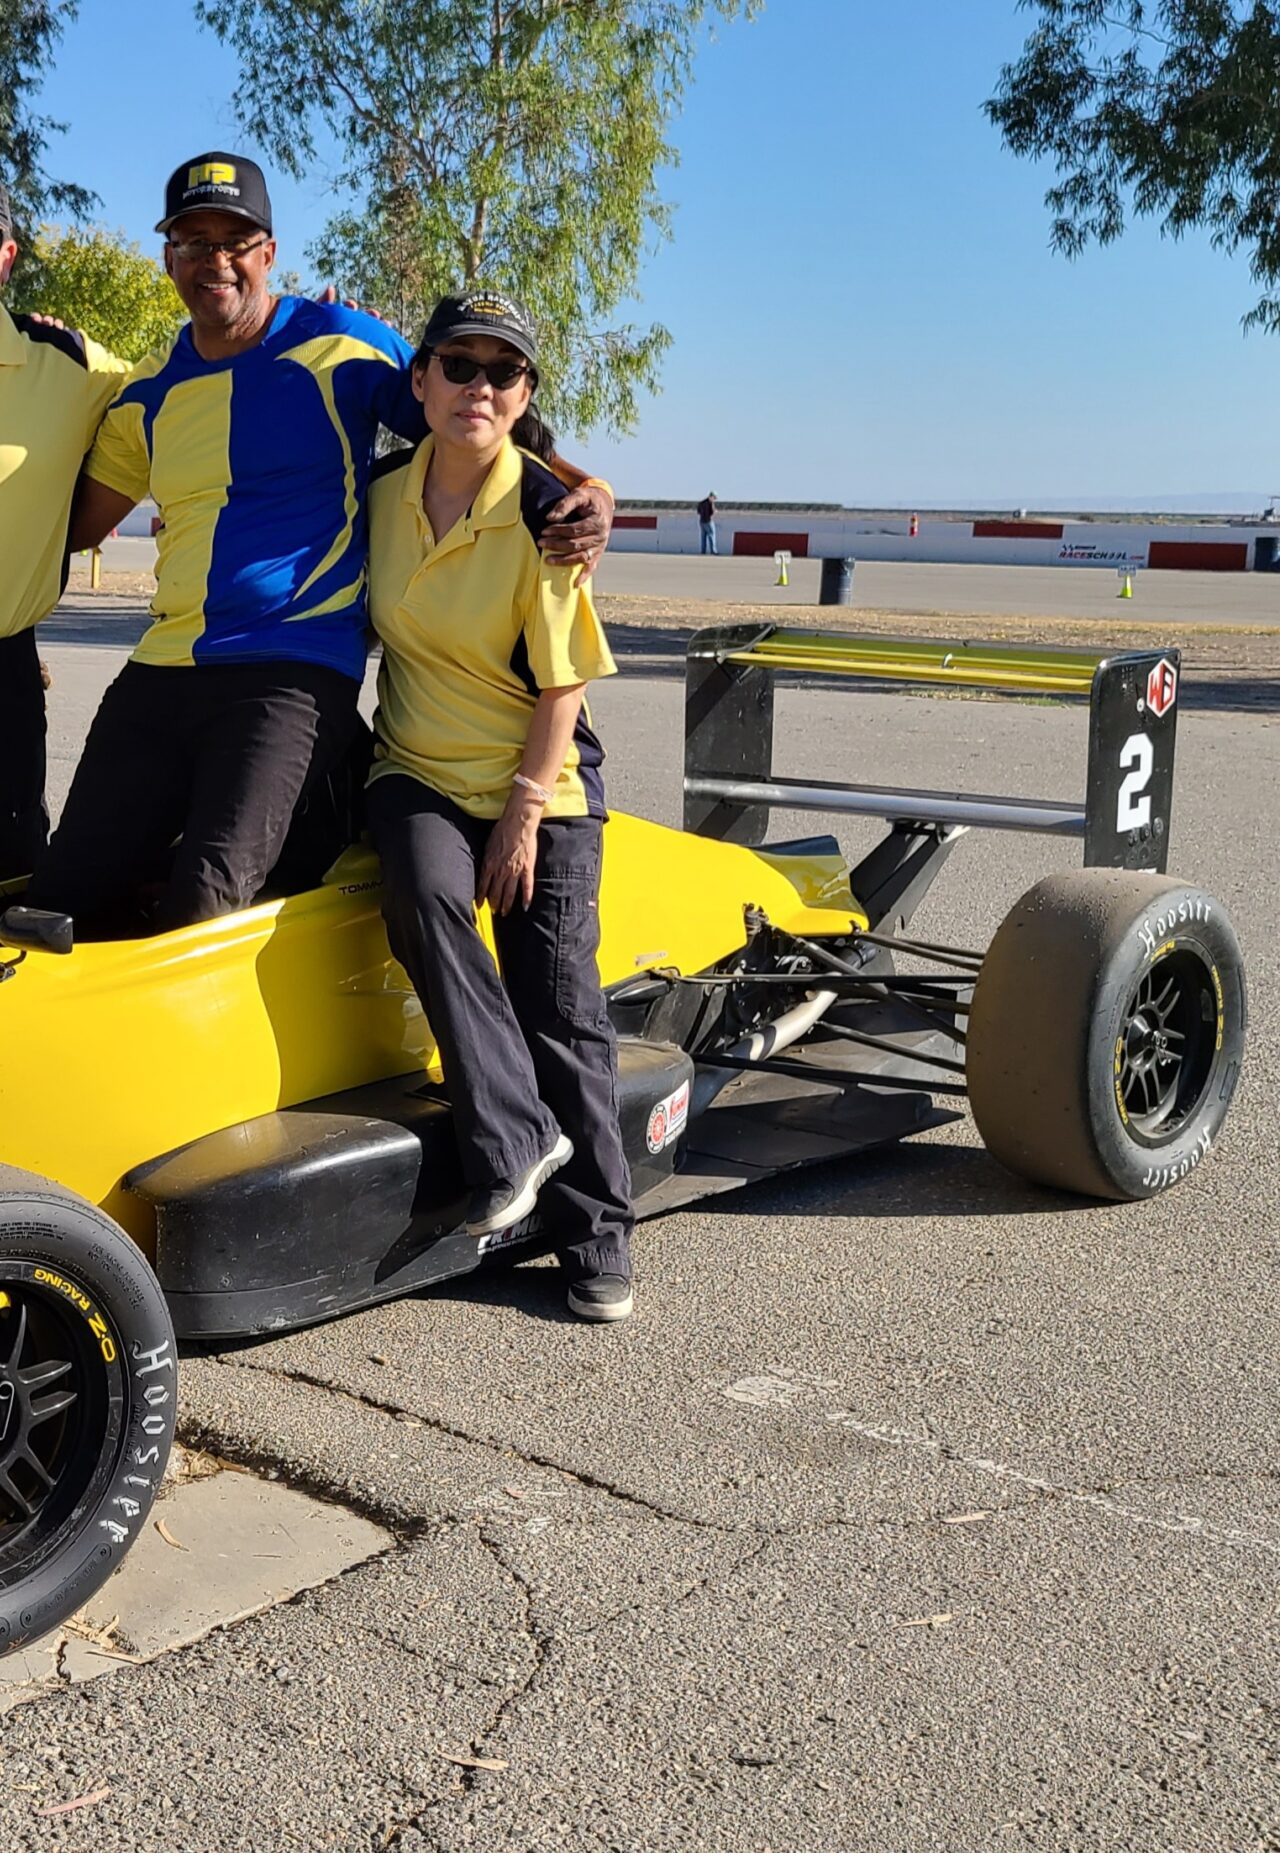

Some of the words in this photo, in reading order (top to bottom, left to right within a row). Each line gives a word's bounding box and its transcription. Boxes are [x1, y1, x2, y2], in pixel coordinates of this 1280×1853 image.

[1116, 732, 1154, 833] 2
[1138, 893, 1211, 960] Hoosier
[34, 1268, 91, 1311] RACING
[99, 1339, 173, 1543] Hoosier
